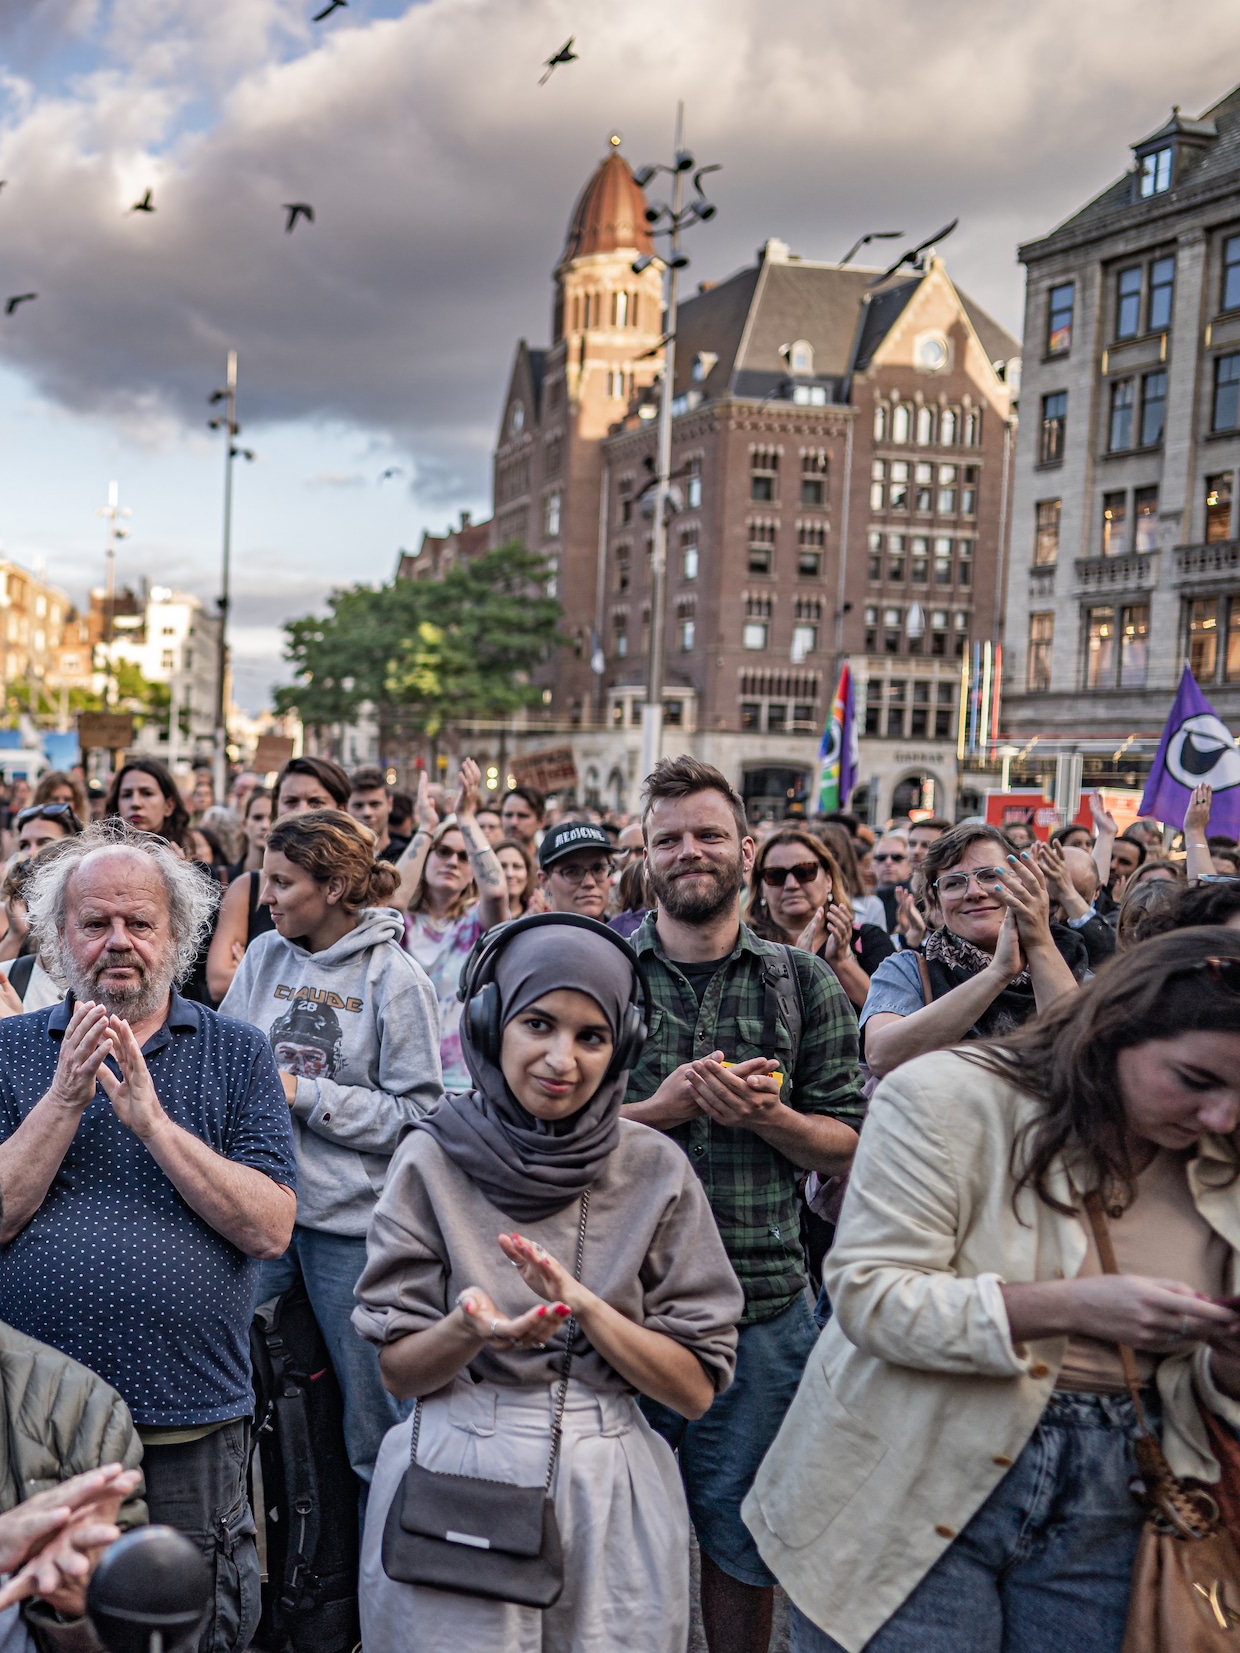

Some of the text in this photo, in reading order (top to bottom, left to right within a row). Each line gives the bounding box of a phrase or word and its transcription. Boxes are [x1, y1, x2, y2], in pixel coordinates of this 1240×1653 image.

[555, 827, 605, 848] MEDICINE
[274, 984, 364, 1013] CLAUDE
[297, 1000, 318, 1012] 28
